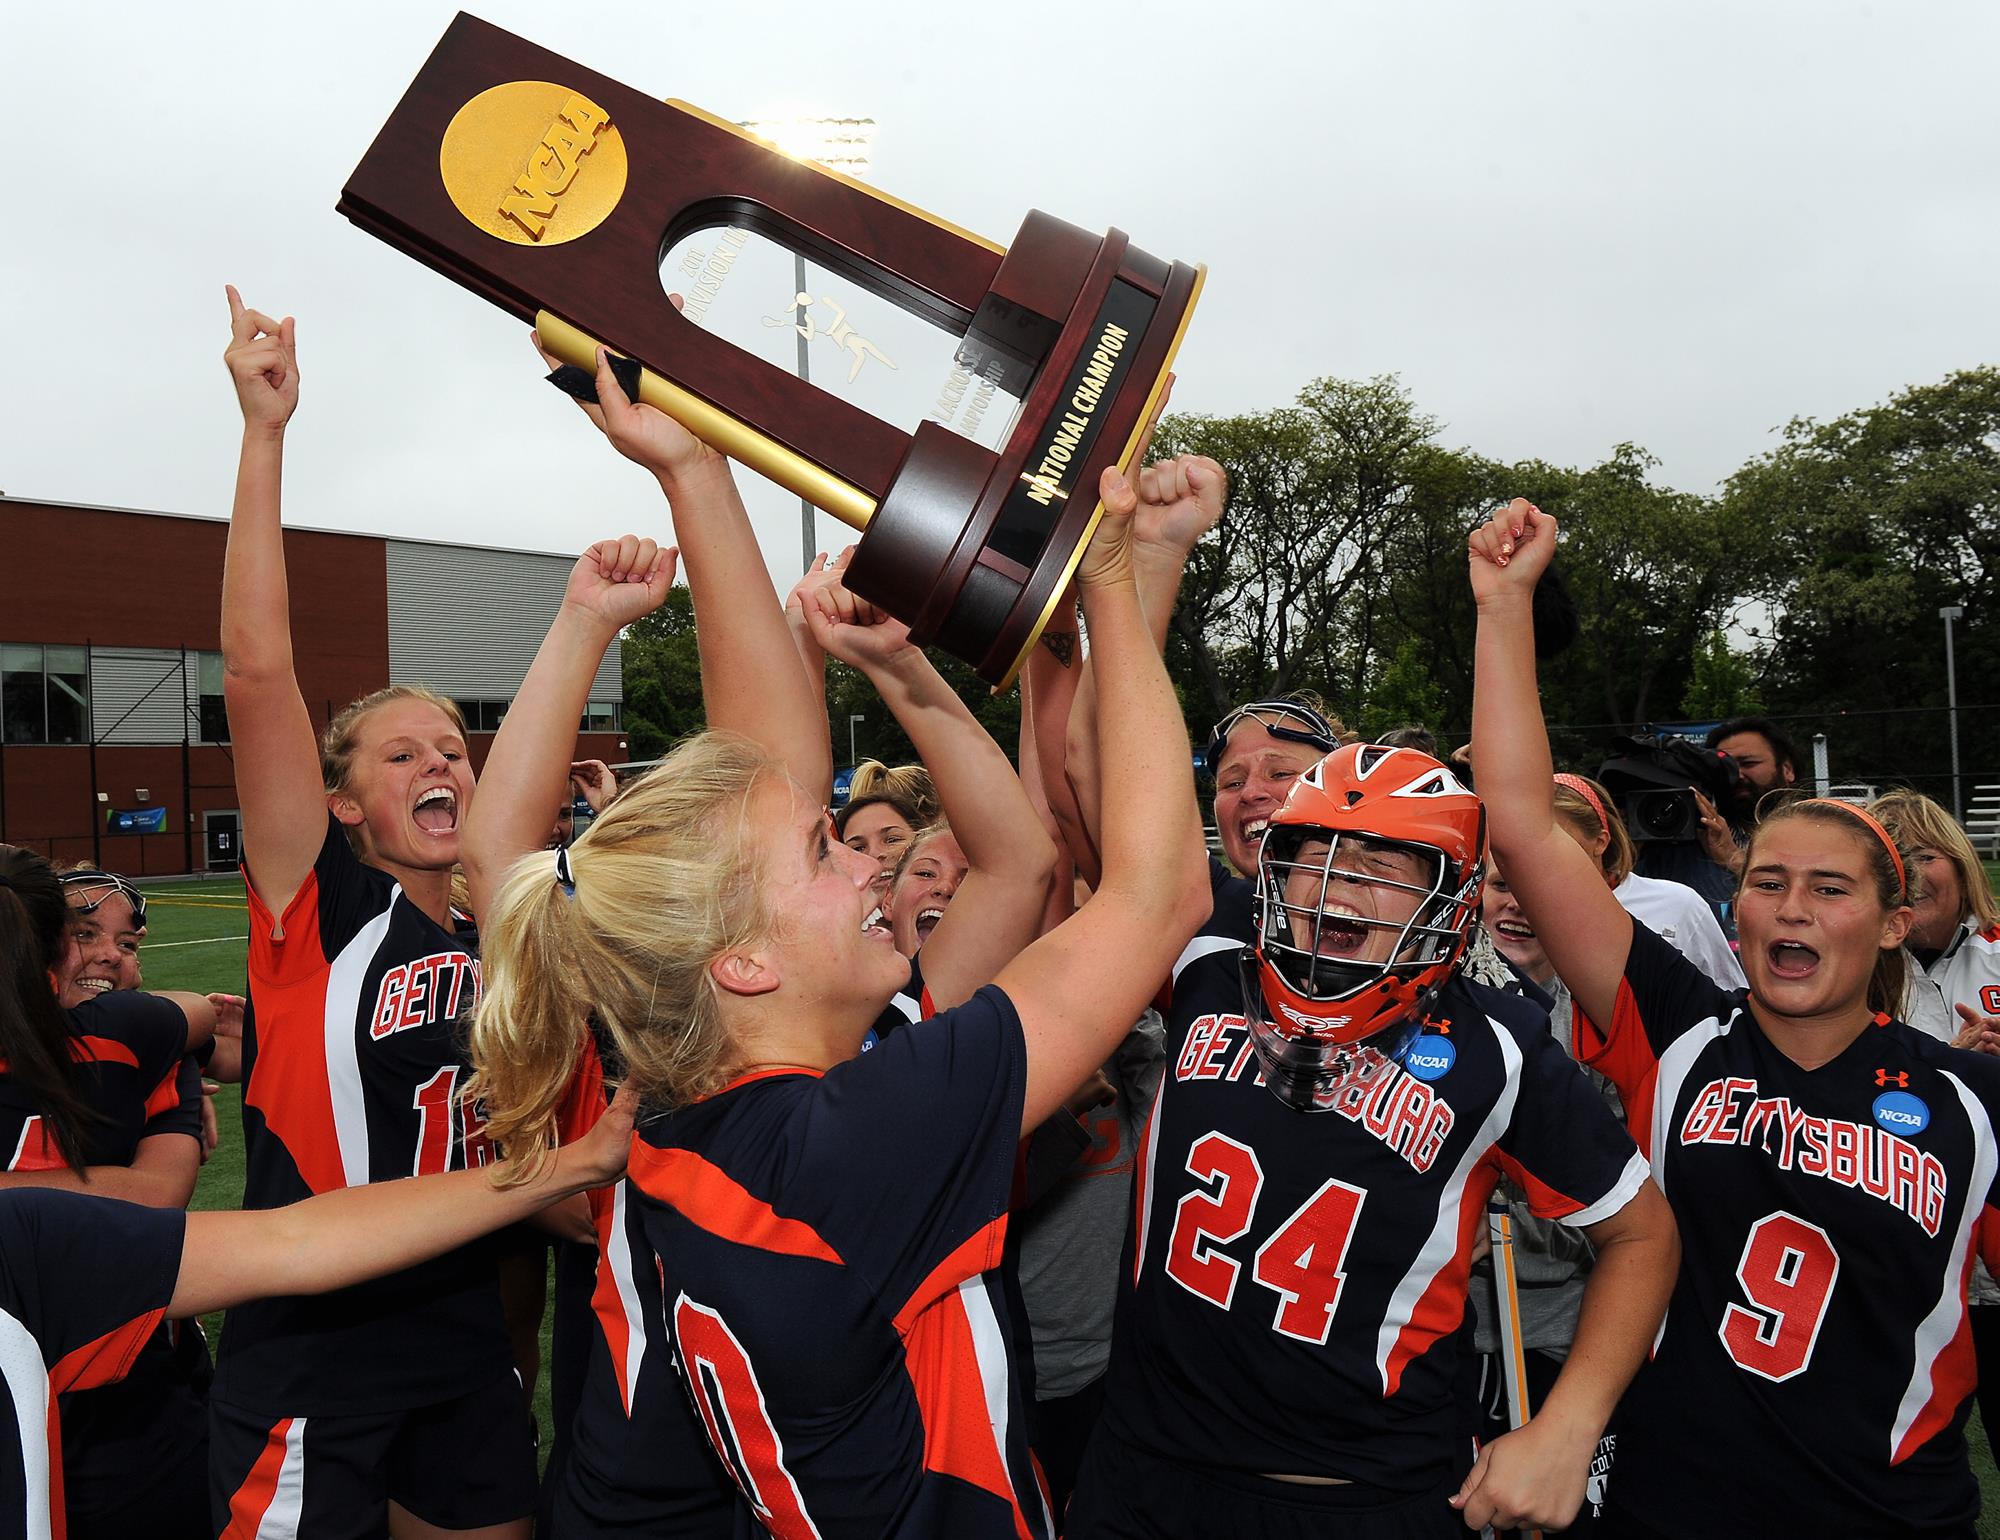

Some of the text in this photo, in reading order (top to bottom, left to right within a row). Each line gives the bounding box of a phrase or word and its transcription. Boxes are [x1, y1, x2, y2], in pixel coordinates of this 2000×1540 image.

[498, 95, 614, 242] NCAA
[679, 247, 706, 278] 2011
[683, 245, 737, 324] DIVISION
[930, 344, 984, 424] LACROSSE
[957, 360, 1006, 438] MPIONSHIP
[1027, 322, 1129, 506] NATIONAL CHAMPION
[1409, 1053, 1449, 1069] NCAA
[1879, 1108, 1922, 1127] NCAA
[1680, 1077, 1947, 1239] GETTYSBURG
[1165, 1130, 1367, 1346] 24
[1718, 1210, 1840, 1383] 9
